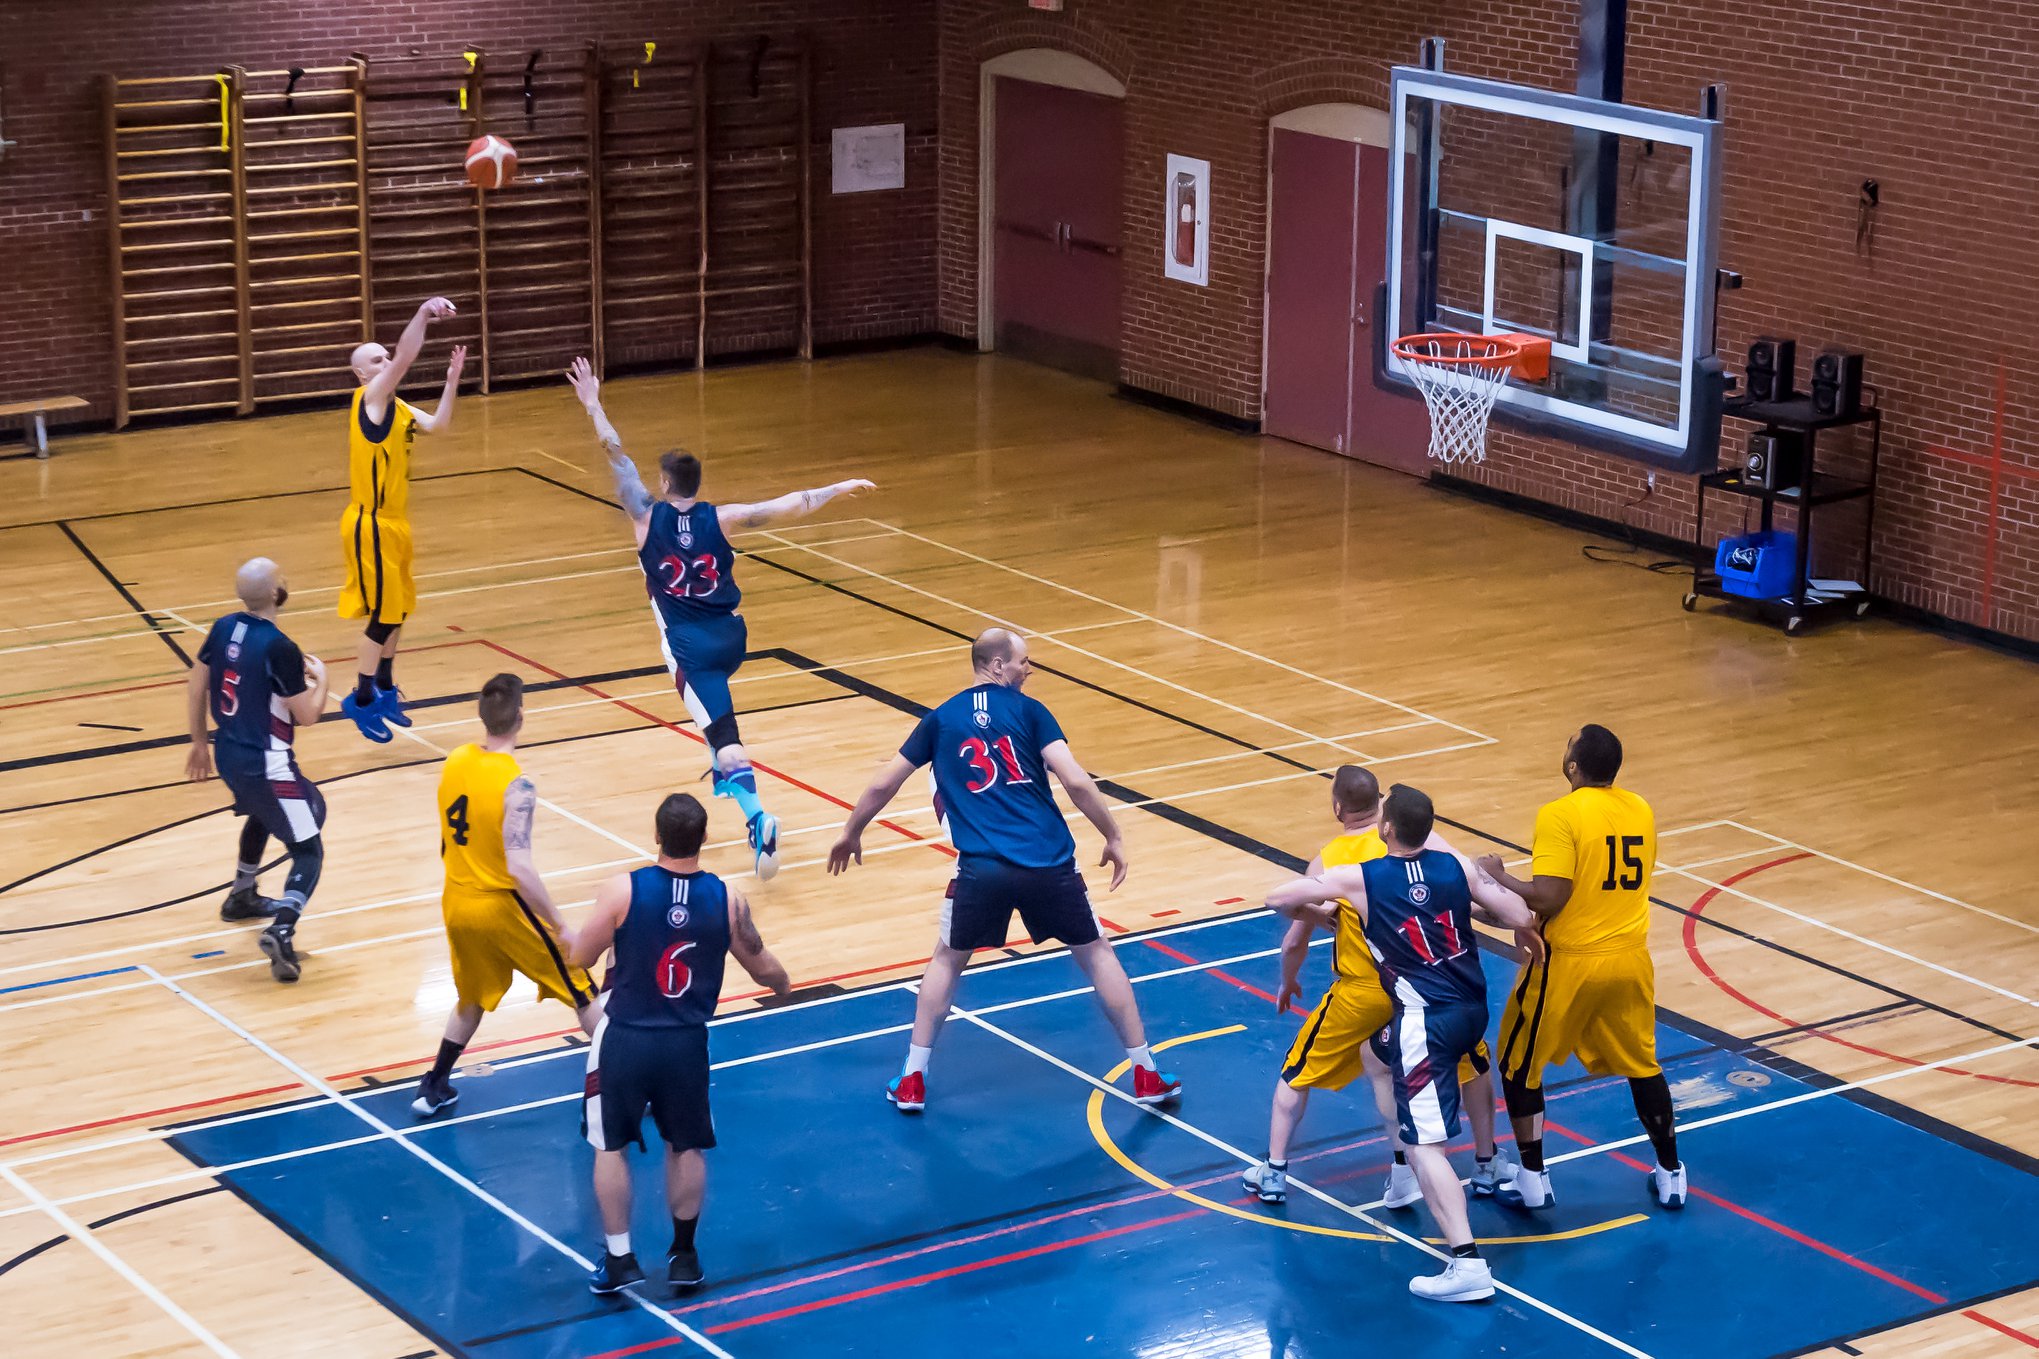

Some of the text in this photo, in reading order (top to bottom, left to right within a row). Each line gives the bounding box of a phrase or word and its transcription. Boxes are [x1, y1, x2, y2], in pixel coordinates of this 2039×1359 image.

[659, 554, 720, 597] 23
[220, 669, 241, 716] 5
[959, 735, 1033, 794] 31
[446, 794, 470, 847] 4
[1602, 835, 1643, 890] 15
[1395, 910, 1468, 966] 11
[656, 941, 696, 998] 6
